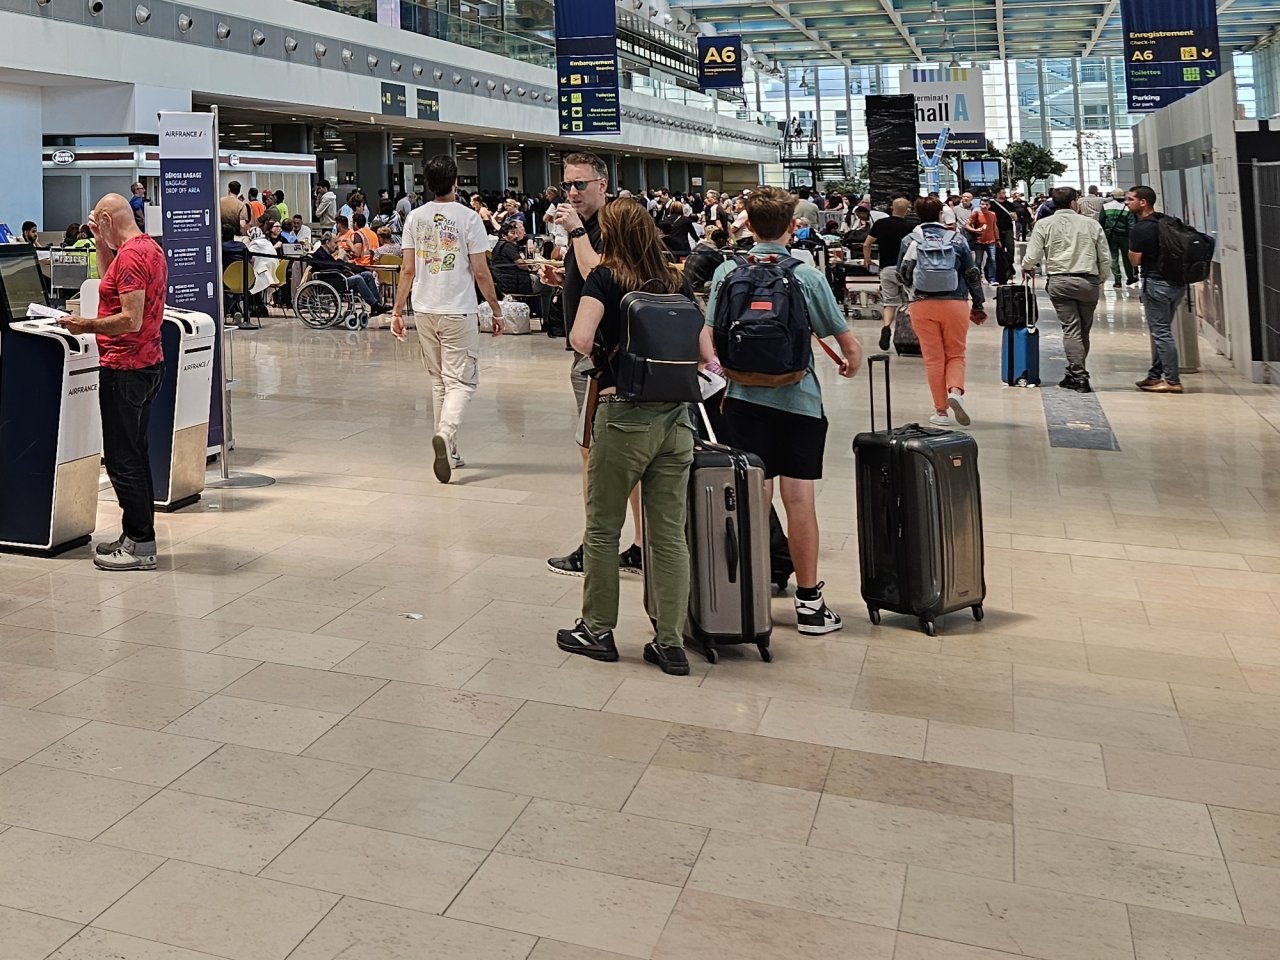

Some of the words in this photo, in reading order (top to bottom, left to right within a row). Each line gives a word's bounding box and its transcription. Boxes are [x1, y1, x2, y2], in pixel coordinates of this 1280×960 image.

[1130, 30, 1194, 39] Enregistrement
[704, 47, 735, 63] A6
[1132, 50, 1153, 61] A6
[915, 103, 949, 122] hall
[954, 94, 969, 121] A
[183, 362, 206, 372] AIRFRANCE
[68, 384, 97, 396] AIRFRANCE
